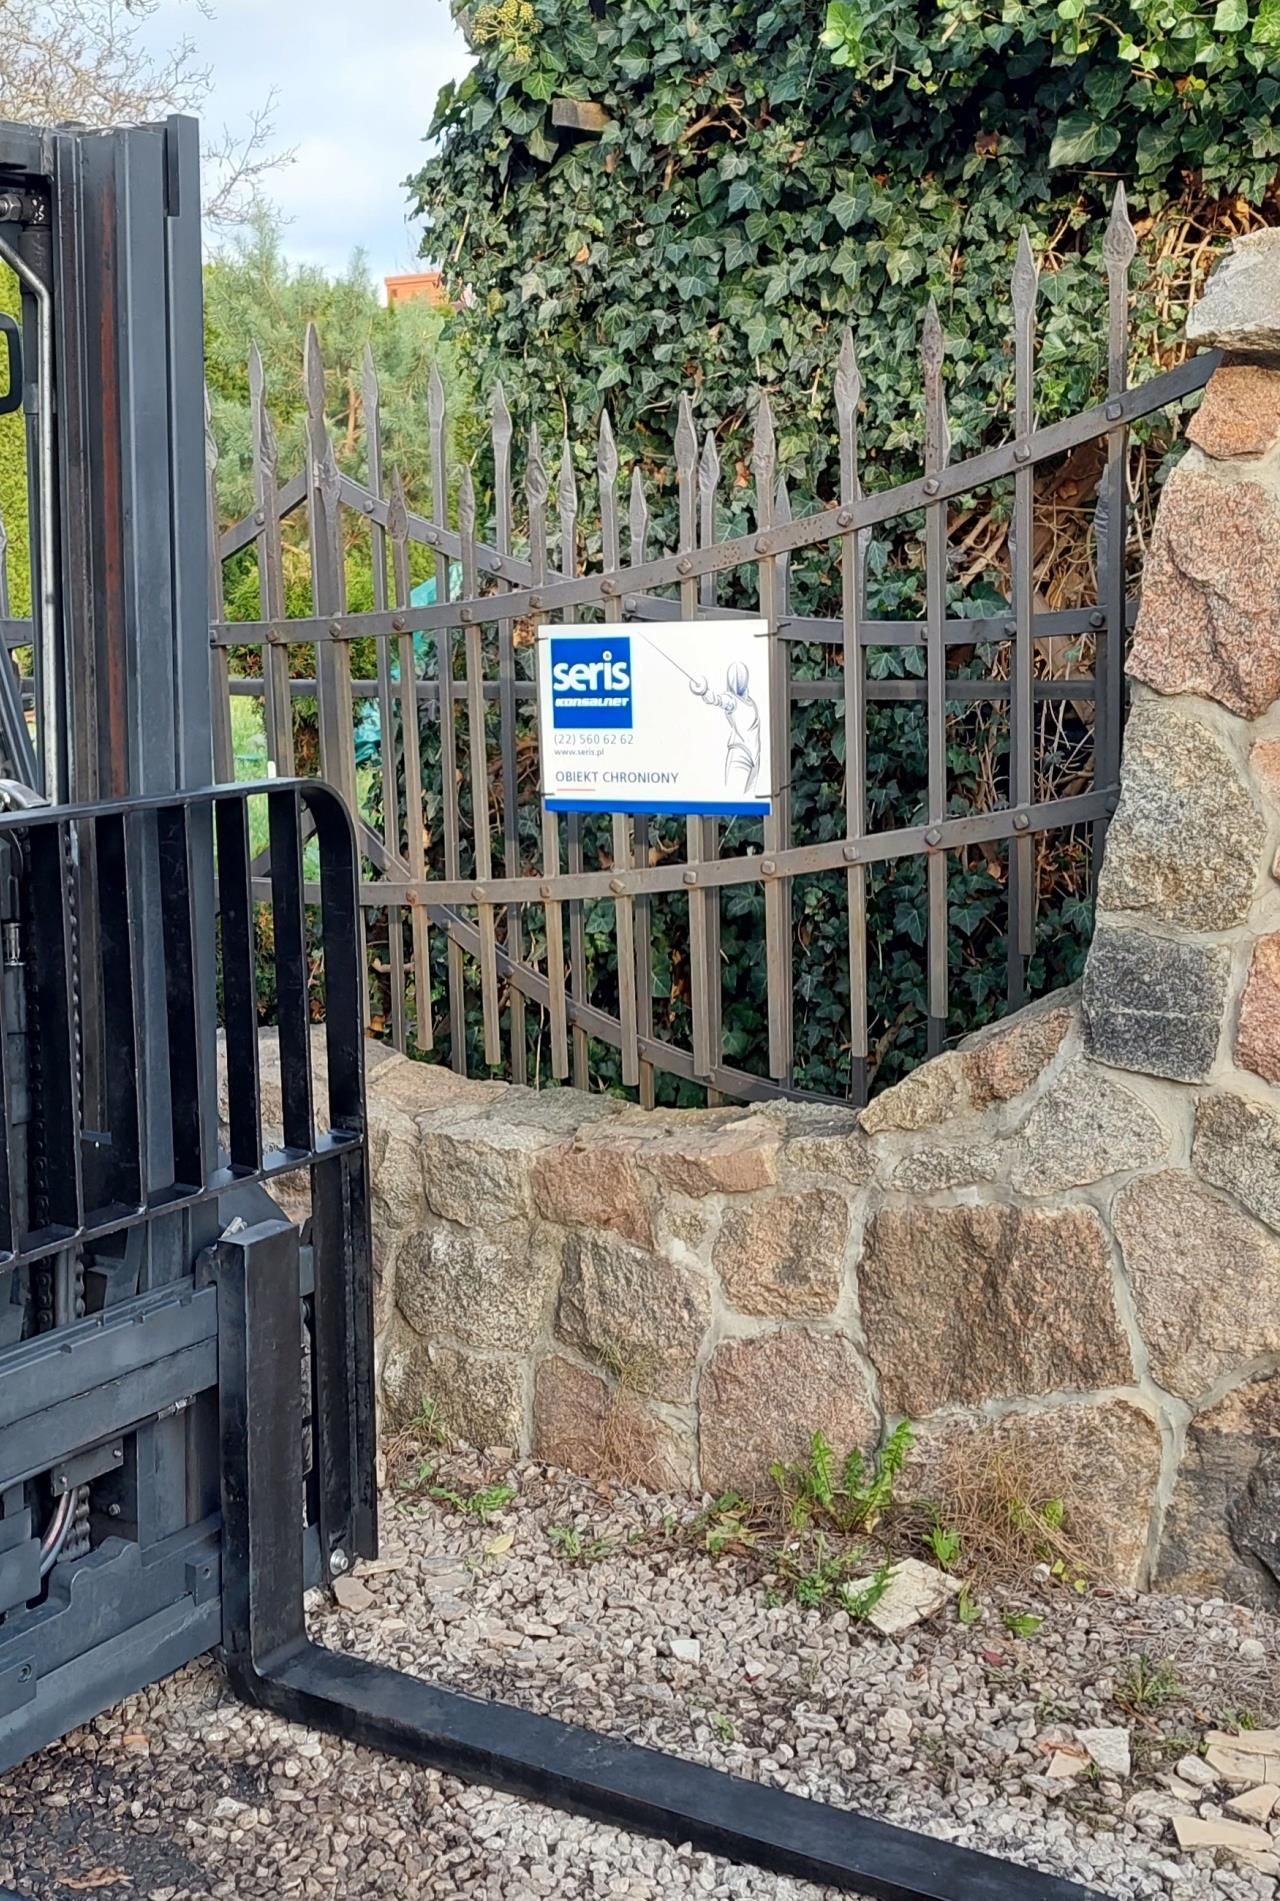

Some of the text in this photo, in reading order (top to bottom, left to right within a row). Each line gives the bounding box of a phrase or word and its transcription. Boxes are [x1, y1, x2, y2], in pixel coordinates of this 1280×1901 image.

[553, 650, 631, 691] seris
[554, 734, 634, 746] (22) 560 62 62
[554, 748, 605, 757] www.seris.pl
[555, 771, 679, 784] OBIEKT CHRONIONY
